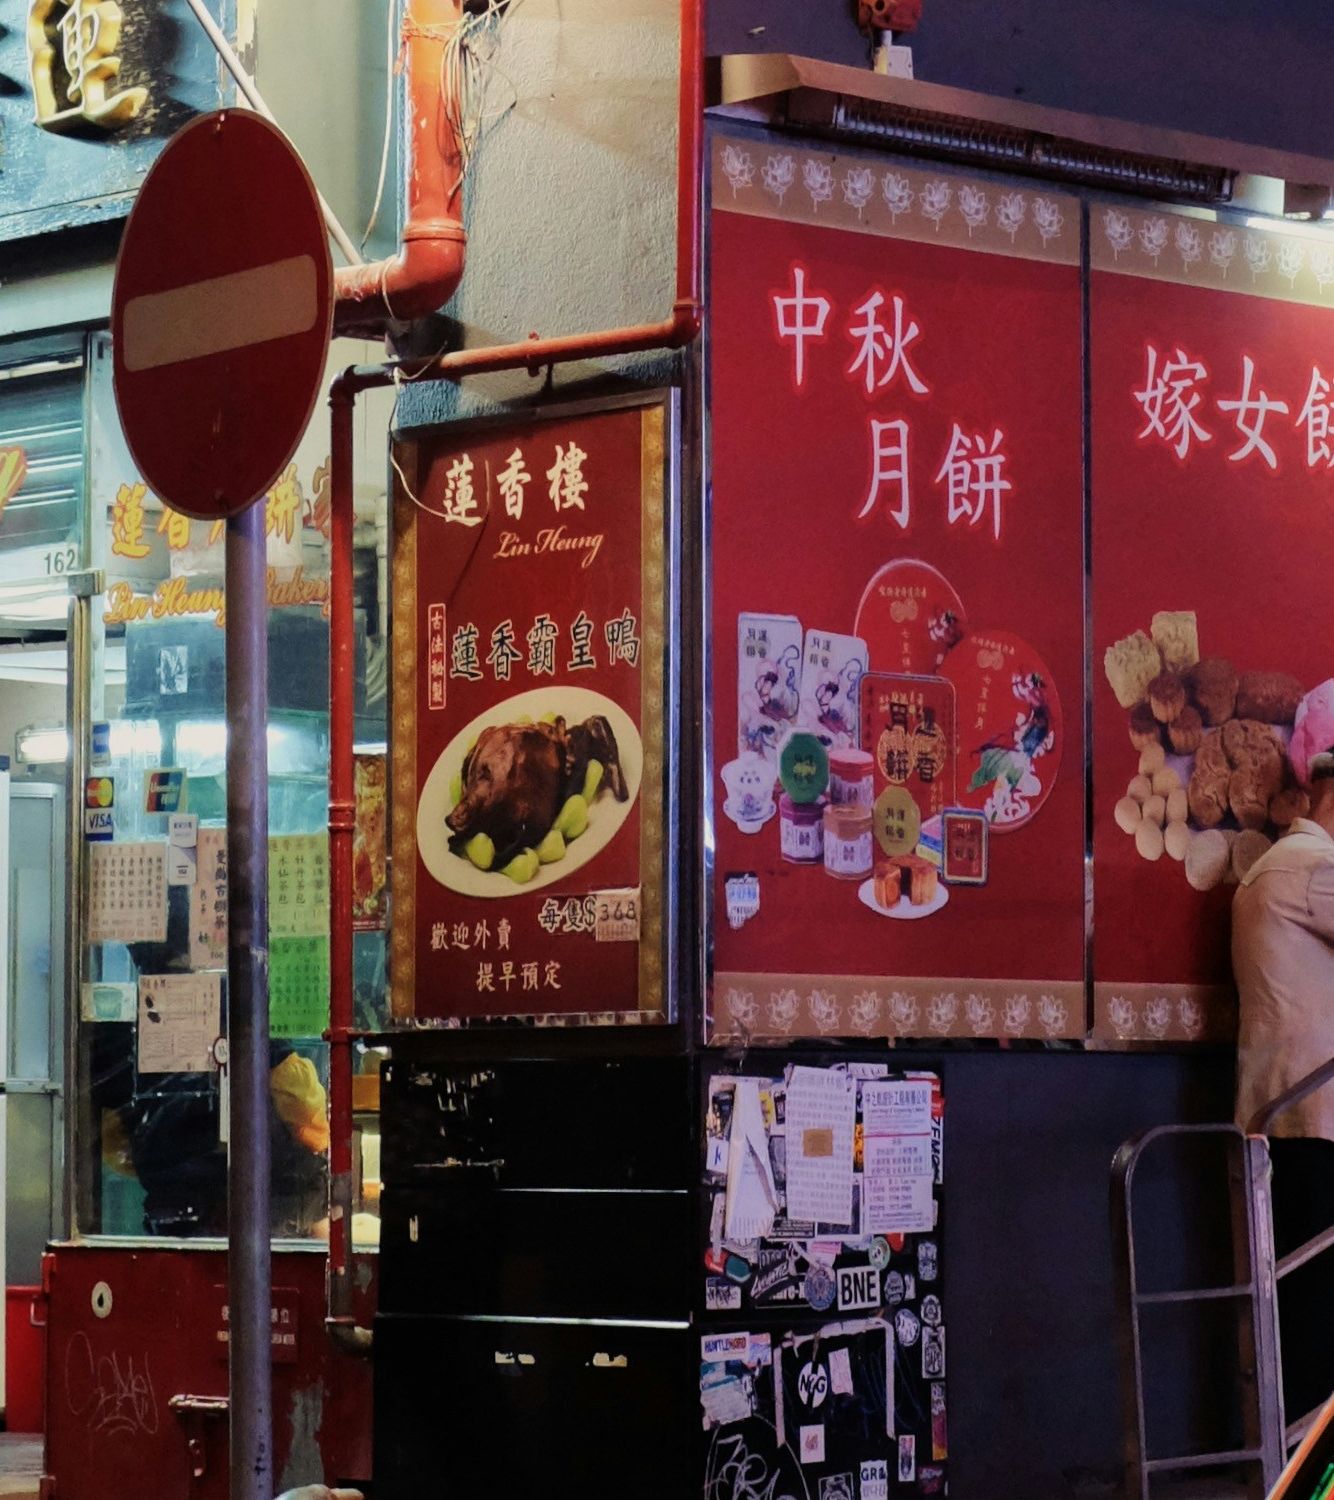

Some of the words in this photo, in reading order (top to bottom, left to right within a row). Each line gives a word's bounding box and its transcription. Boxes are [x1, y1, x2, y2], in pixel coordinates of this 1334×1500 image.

[771, 266, 930, 398] 中秋
[443, 441, 589, 527] 蓮香樓
[857, 418, 1012, 540] 月餅
[43, 549, 77, 576] 162
[493, 529, 534, 562] Lin
[531, 525, 605, 569] Heung
[103, 581, 154, 624] Lin
[450, 609, 641, 682] 蓮香霸皇鴨
[89, 812, 113, 830] VISA
[430, 917, 513, 952] 歡迎外賣
[475, 960, 562, 992] 提早預定
[841, 1271, 878, 1306] BNE
